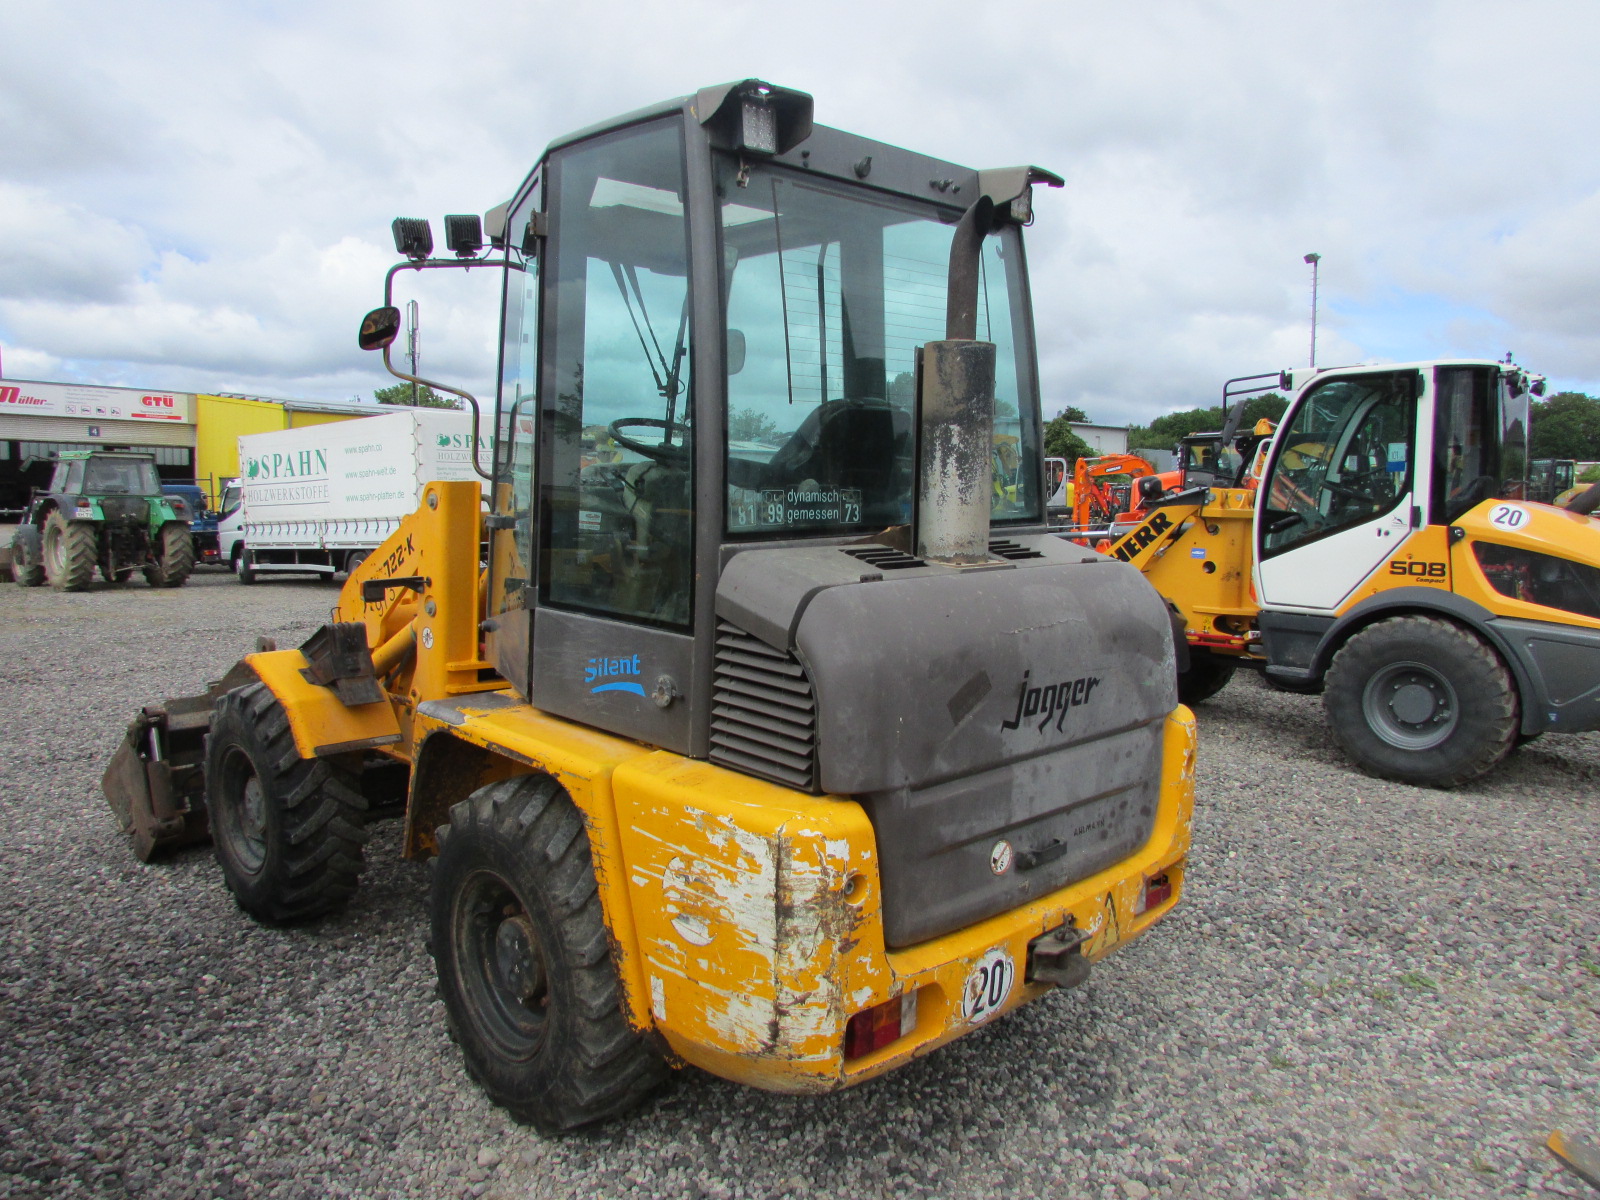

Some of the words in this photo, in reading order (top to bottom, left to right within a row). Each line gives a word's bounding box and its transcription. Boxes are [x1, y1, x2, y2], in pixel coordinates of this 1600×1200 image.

[141, 394, 174, 408] GTÜ
[91, 428, 98, 436] 4
[261, 449, 328, 479] SPAHN
[248, 484, 329, 503] HOLZWERKSTOFFE
[787, 489, 839, 505] dynamisch
[768, 504, 783, 522] 99
[787, 508, 839, 523] gemessen
[845, 504, 859, 522] 73
[1494, 506, 1523, 526] 20
[1389, 561, 1446, 577] 508
[584, 654, 641, 683] Silent
[1001, 670, 1101, 735] jogger
[972, 959, 1004, 1014] 20
